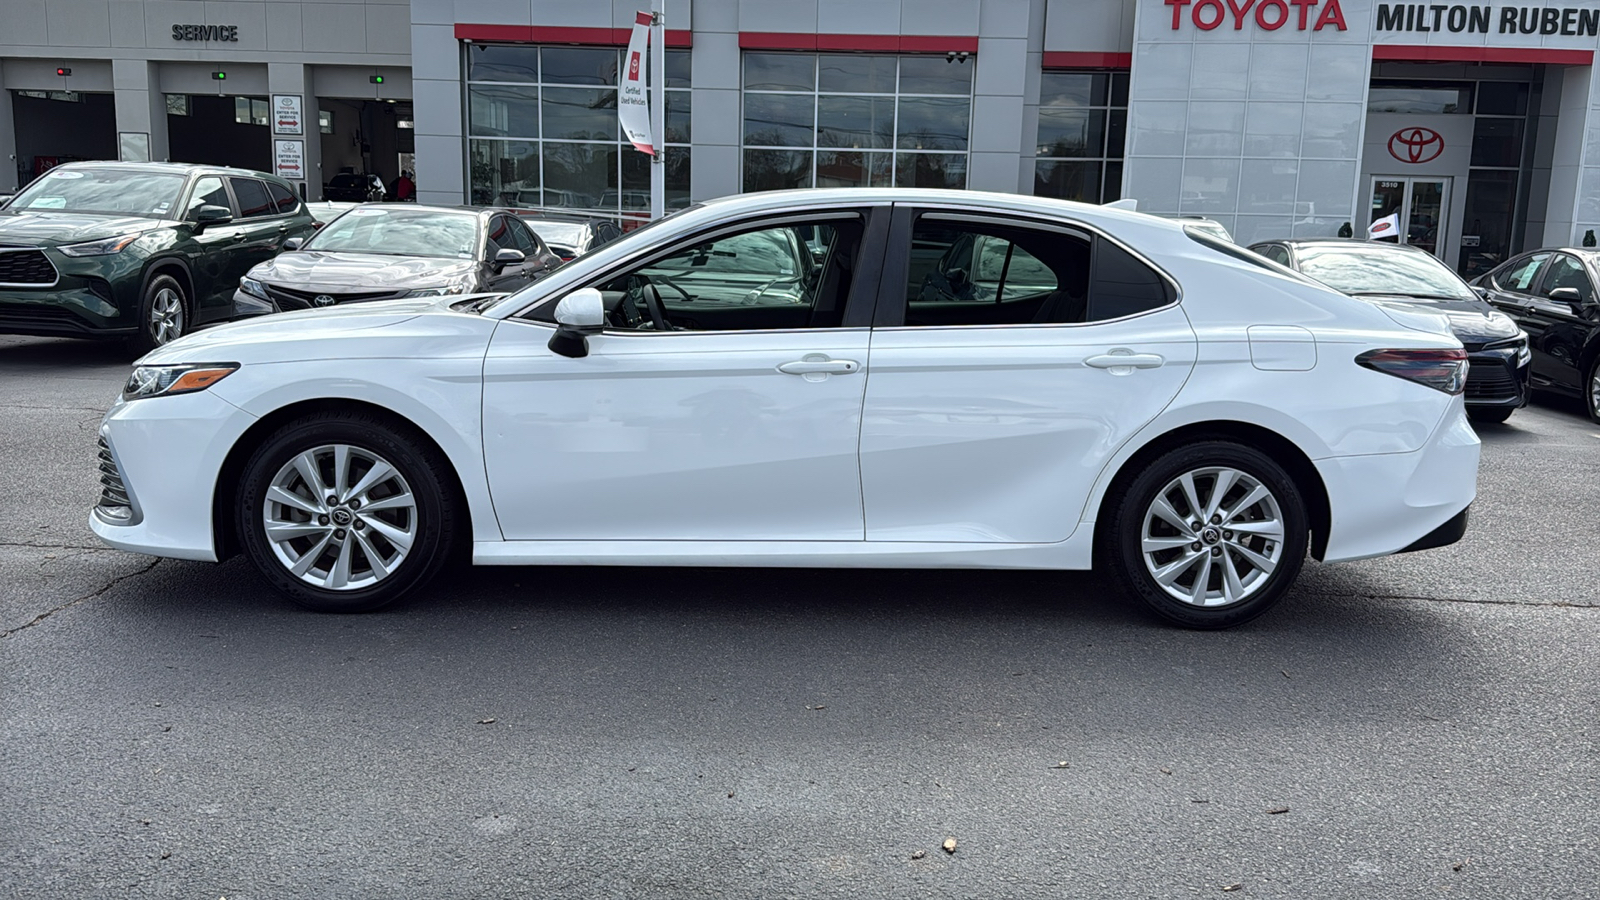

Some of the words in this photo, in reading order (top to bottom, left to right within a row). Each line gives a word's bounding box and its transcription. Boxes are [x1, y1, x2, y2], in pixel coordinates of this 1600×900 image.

[1164, 0, 1348, 31] TOYOTA
[1376, 4, 1491, 33] MILTON
[1500, 7, 1600, 36] RUBEN
[172, 24, 238, 42] SERVICE
[625, 85, 641, 95] Certified
[621, 97, 630, 105] Used
[630, 97, 646, 106] Vehicles
